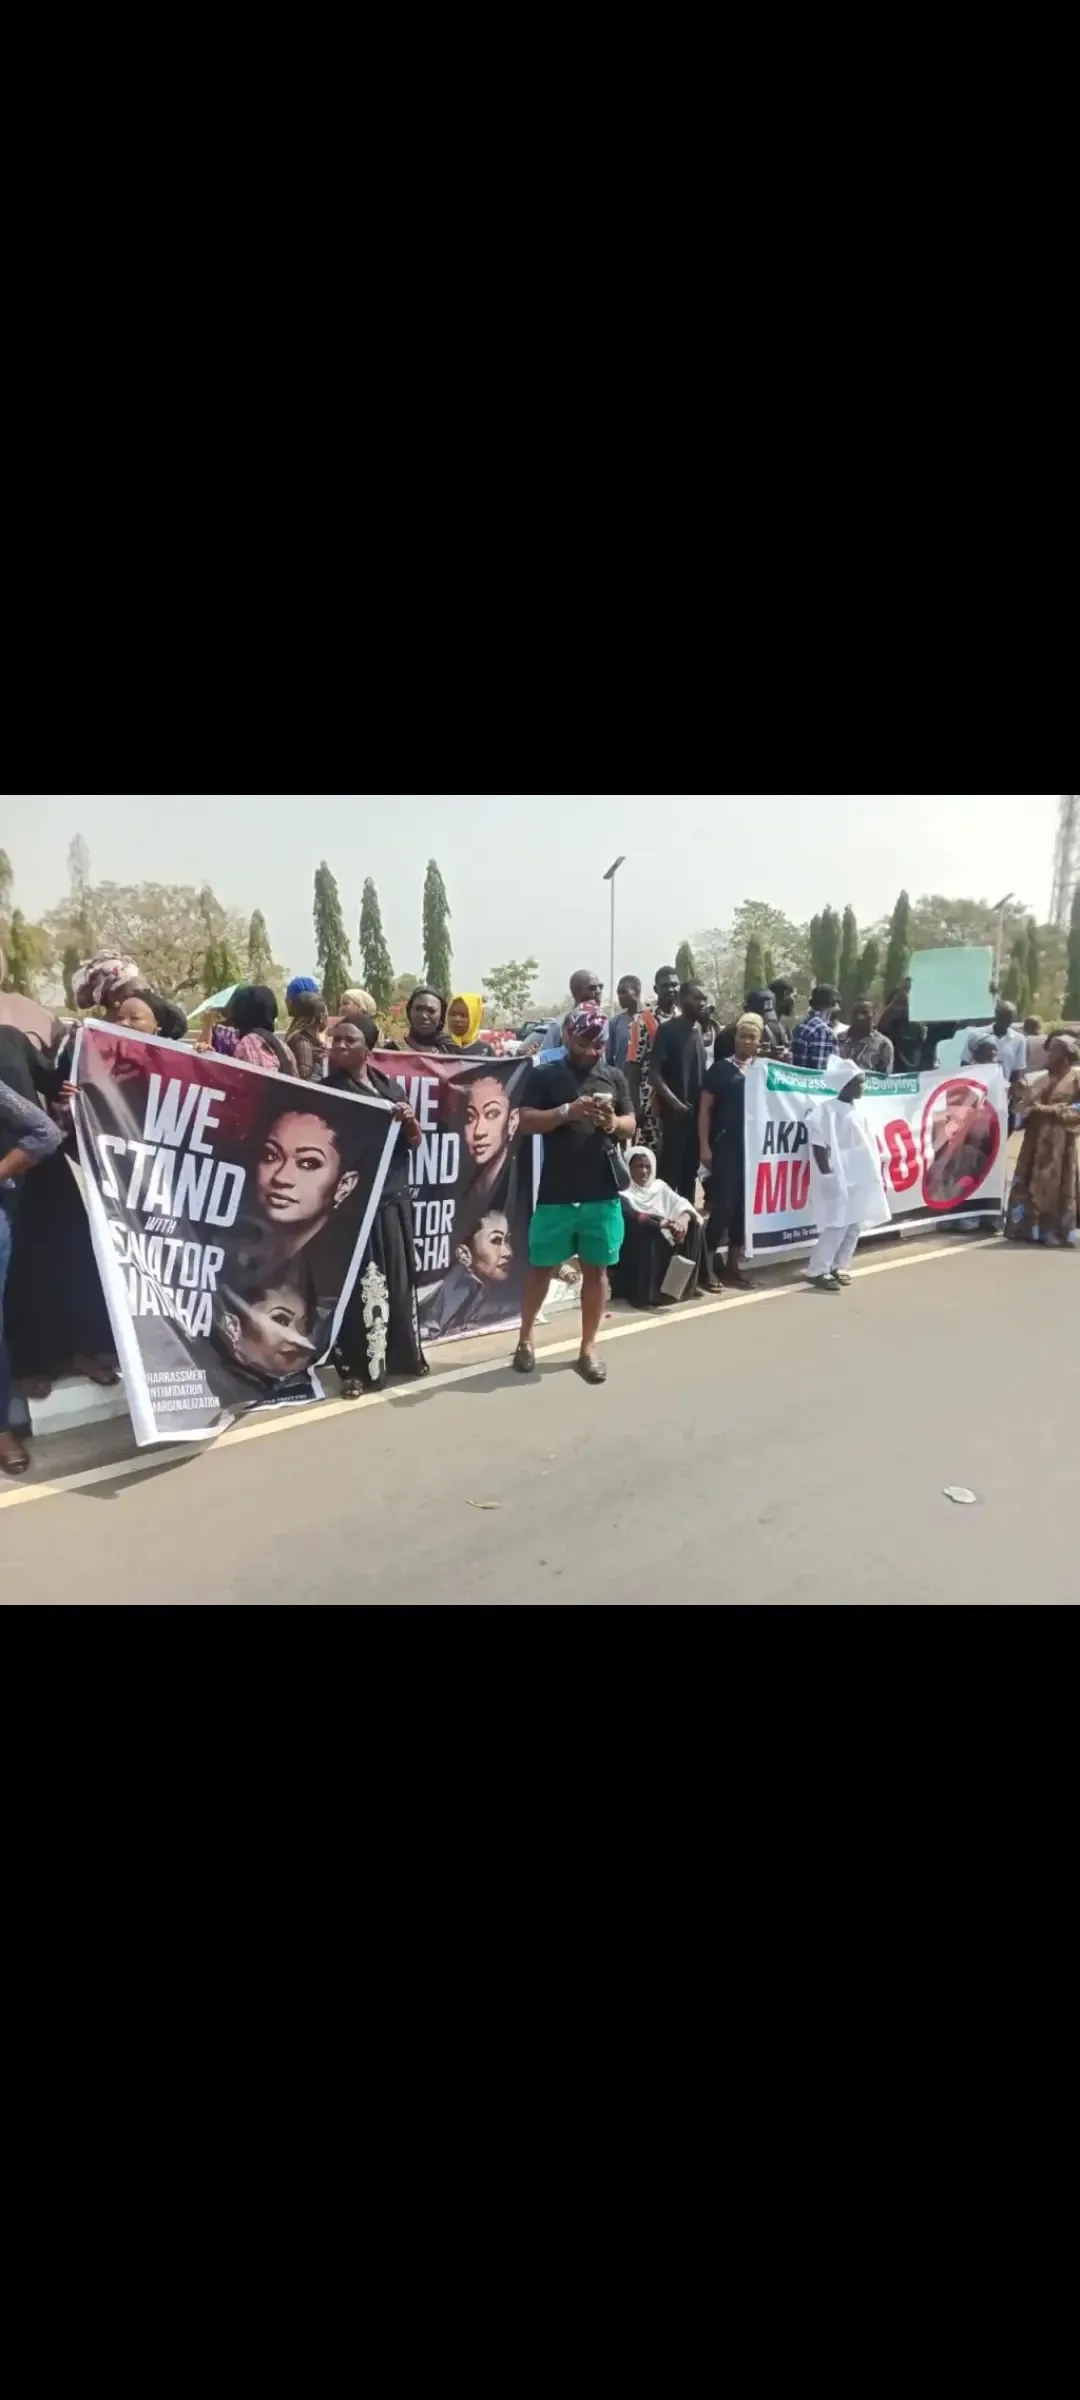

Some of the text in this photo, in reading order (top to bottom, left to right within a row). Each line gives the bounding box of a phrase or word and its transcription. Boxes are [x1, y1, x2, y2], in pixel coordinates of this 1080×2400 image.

[143, 1073, 226, 1155] WE
[762, 1121, 809, 1155] AKP
[97, 1134, 246, 1227] STAND
[143, 1216, 177, 1235] WITH
[150, 1384, 204, 1399] NTIMIDATION
